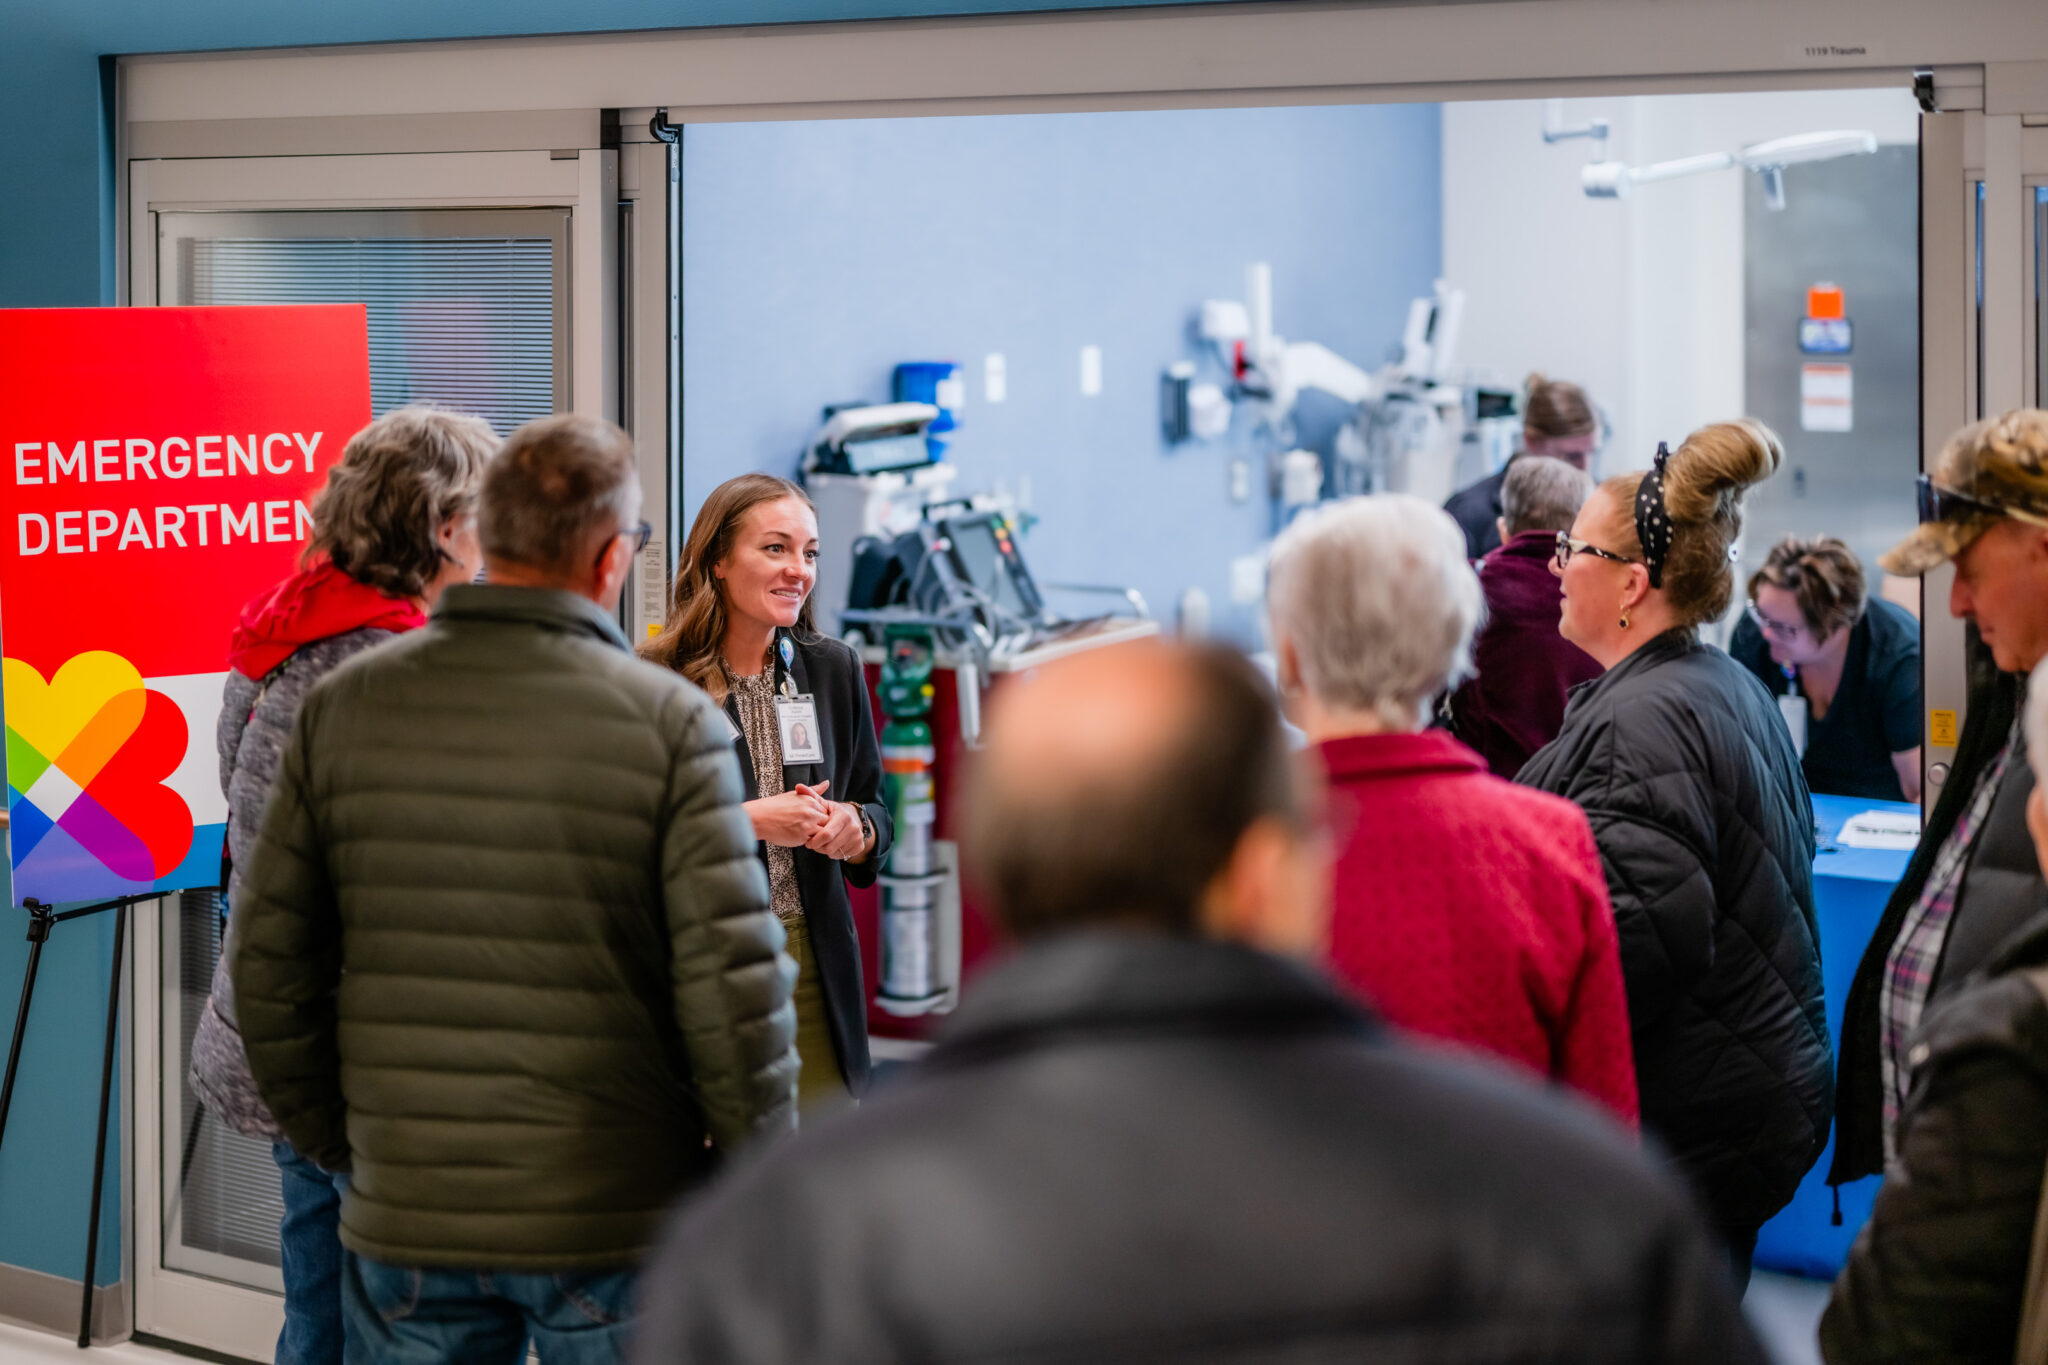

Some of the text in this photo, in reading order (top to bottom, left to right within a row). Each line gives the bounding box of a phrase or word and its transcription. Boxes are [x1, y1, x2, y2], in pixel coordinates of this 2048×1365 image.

[1830, 46, 1866, 55] Trauma
[14, 431, 323, 485] EMERGENCY
[17, 499, 316, 556] DEPARTMEN
